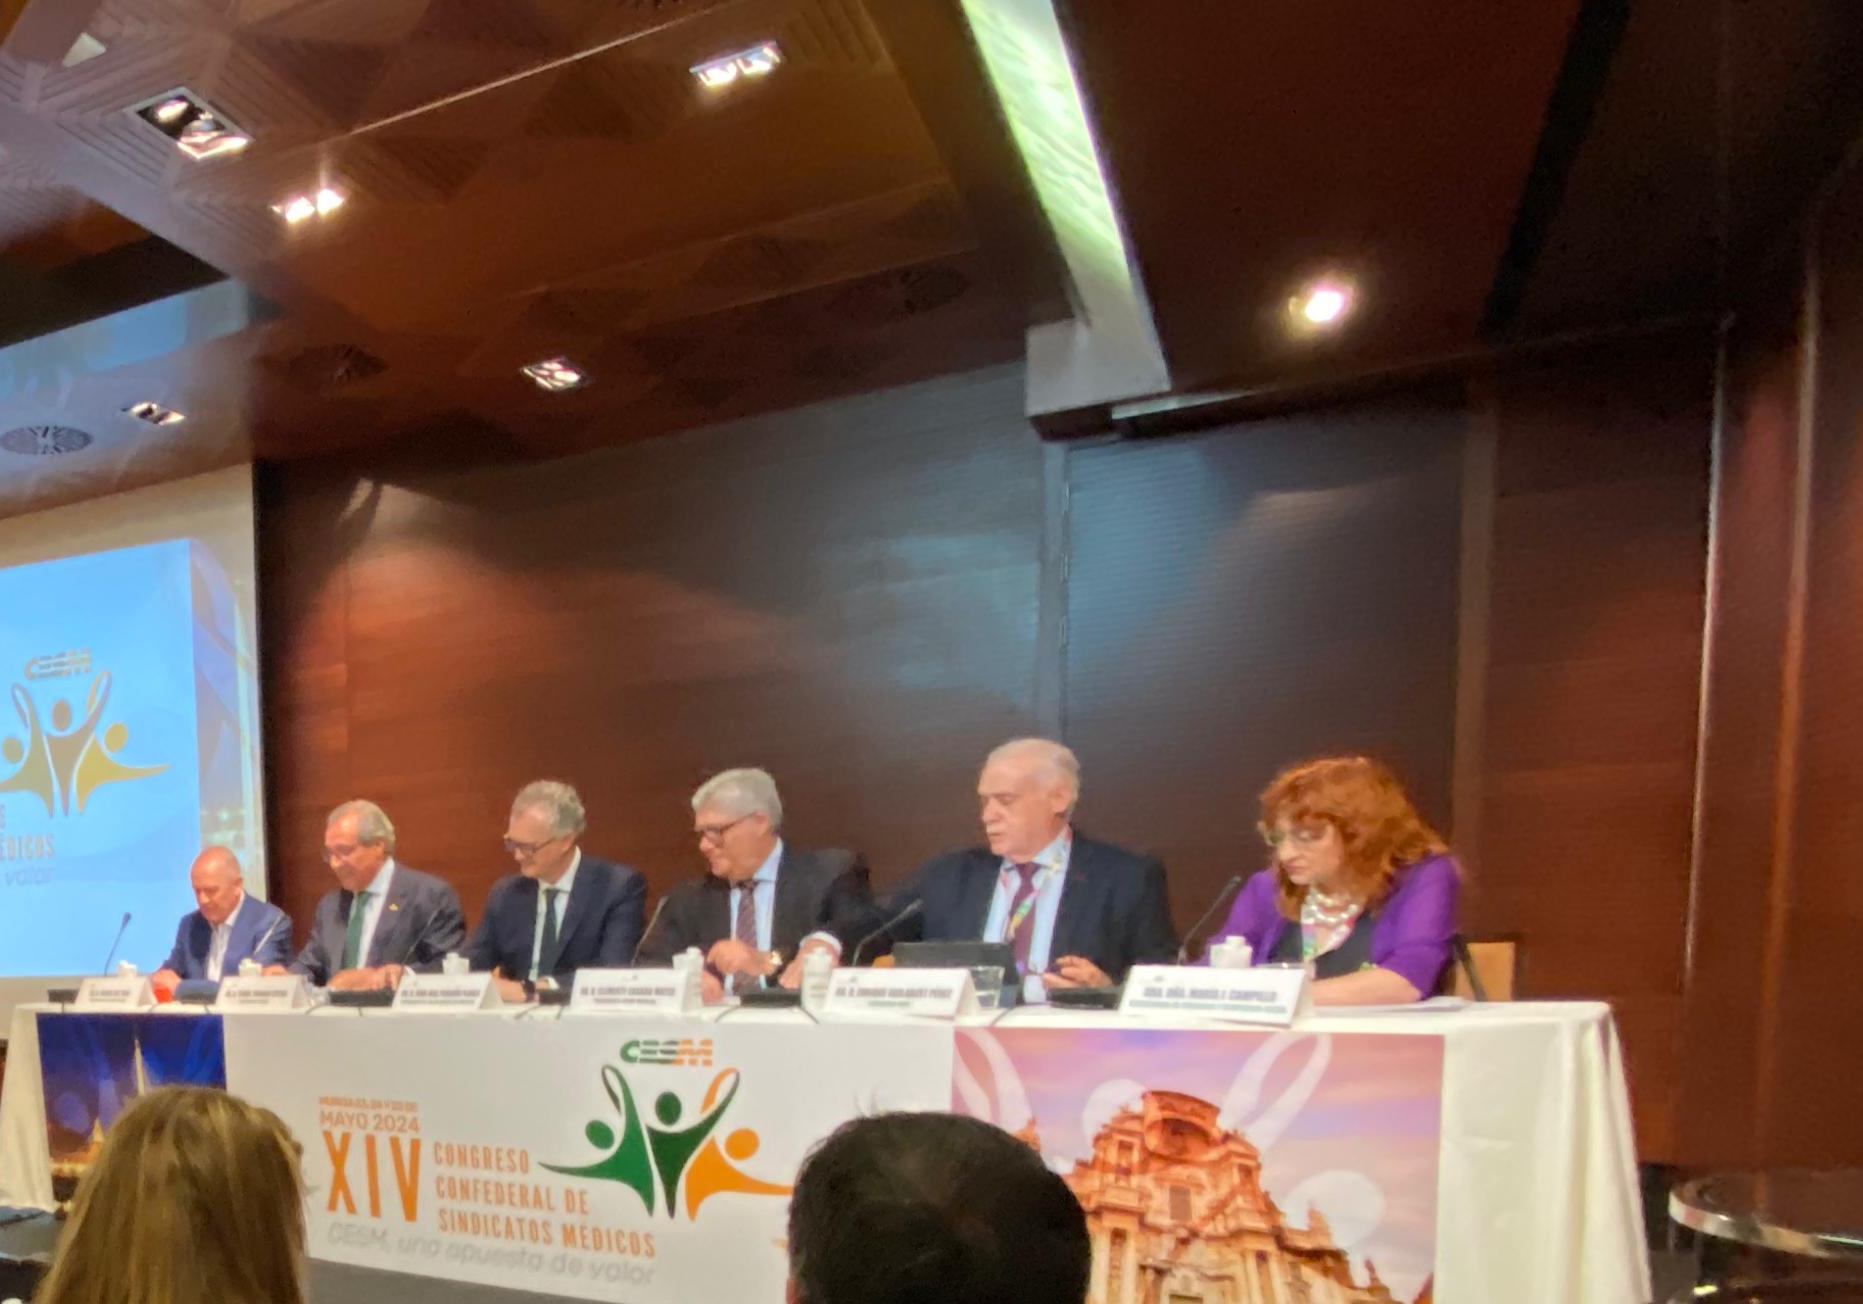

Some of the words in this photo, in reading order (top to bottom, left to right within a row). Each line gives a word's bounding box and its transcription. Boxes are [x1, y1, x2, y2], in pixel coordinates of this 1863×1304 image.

[319, 1110, 367, 1130] MAYO
[373, 1114, 420, 1133] 2024
[323, 1129, 421, 1222] XIV
[434, 1141, 529, 1174] CONGRESO
[435, 1175, 555, 1211] CONFEDERAL
[564, 1188, 589, 1215] DE
[438, 1208, 552, 1245] SINDICATOS
